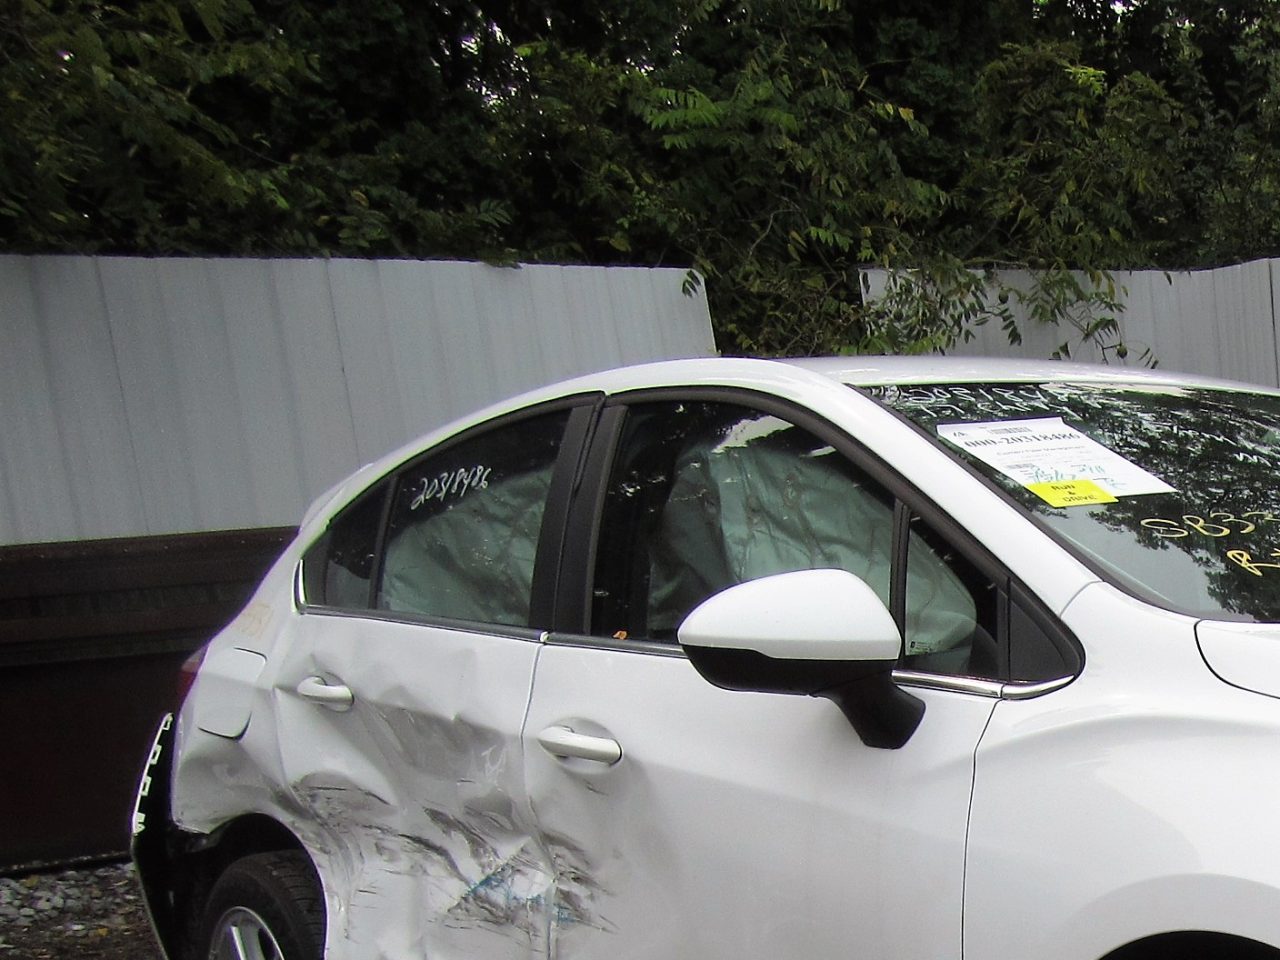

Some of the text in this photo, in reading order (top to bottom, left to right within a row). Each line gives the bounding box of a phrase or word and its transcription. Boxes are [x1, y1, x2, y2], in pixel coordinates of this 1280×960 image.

[964, 432, 1081, 448] 000-20318486
[410, 465, 492, 511] 20318486
[1063, 494, 1097, 502] DRIVE
